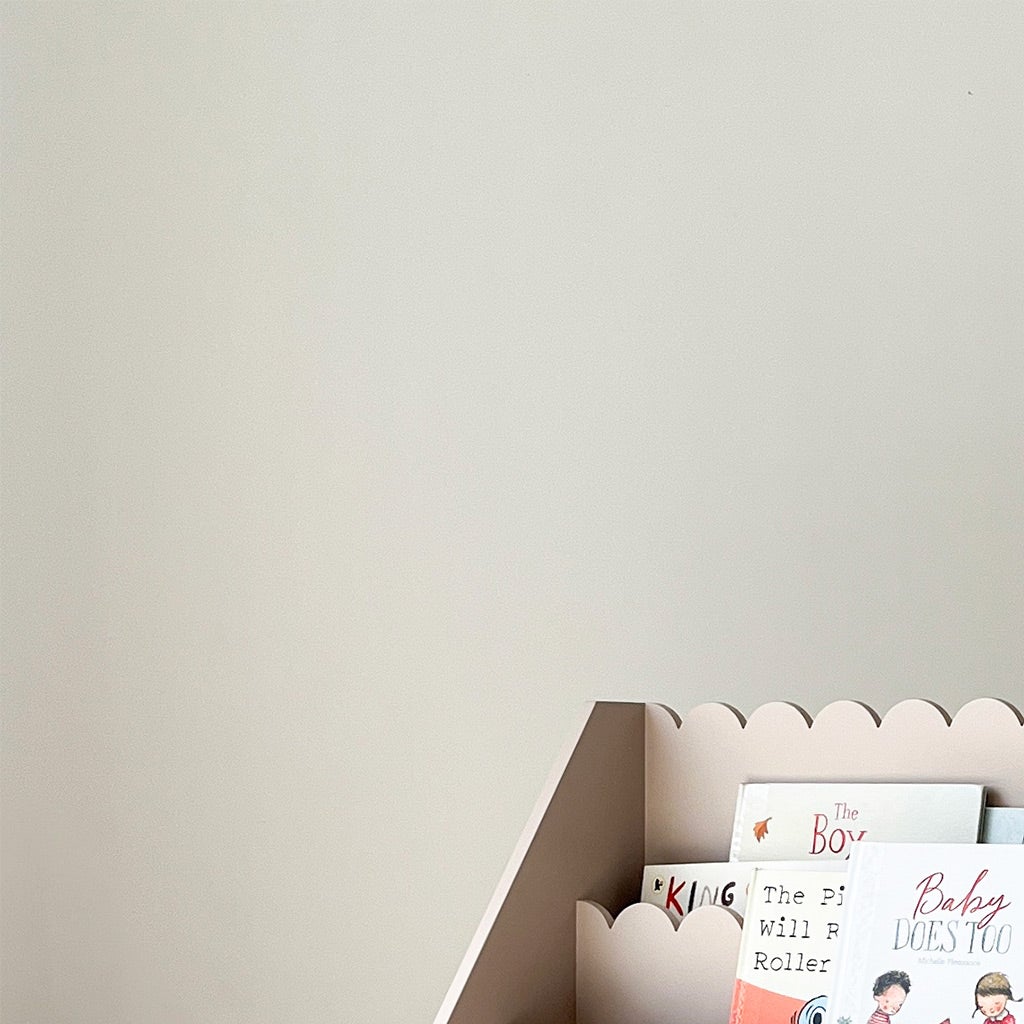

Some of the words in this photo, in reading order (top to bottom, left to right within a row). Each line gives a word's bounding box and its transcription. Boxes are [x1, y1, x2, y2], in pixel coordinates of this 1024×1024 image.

[834, 802, 859, 821] The
[665, 875, 736, 917] KING
[763, 884, 805, 905] The
[913, 868, 1012, 930] Baby
[760, 916, 811, 939] Will
[892, 918, 960, 953] DOES
[965, 921, 1013, 955] TOO
[753, 951, 832, 973] Roller
